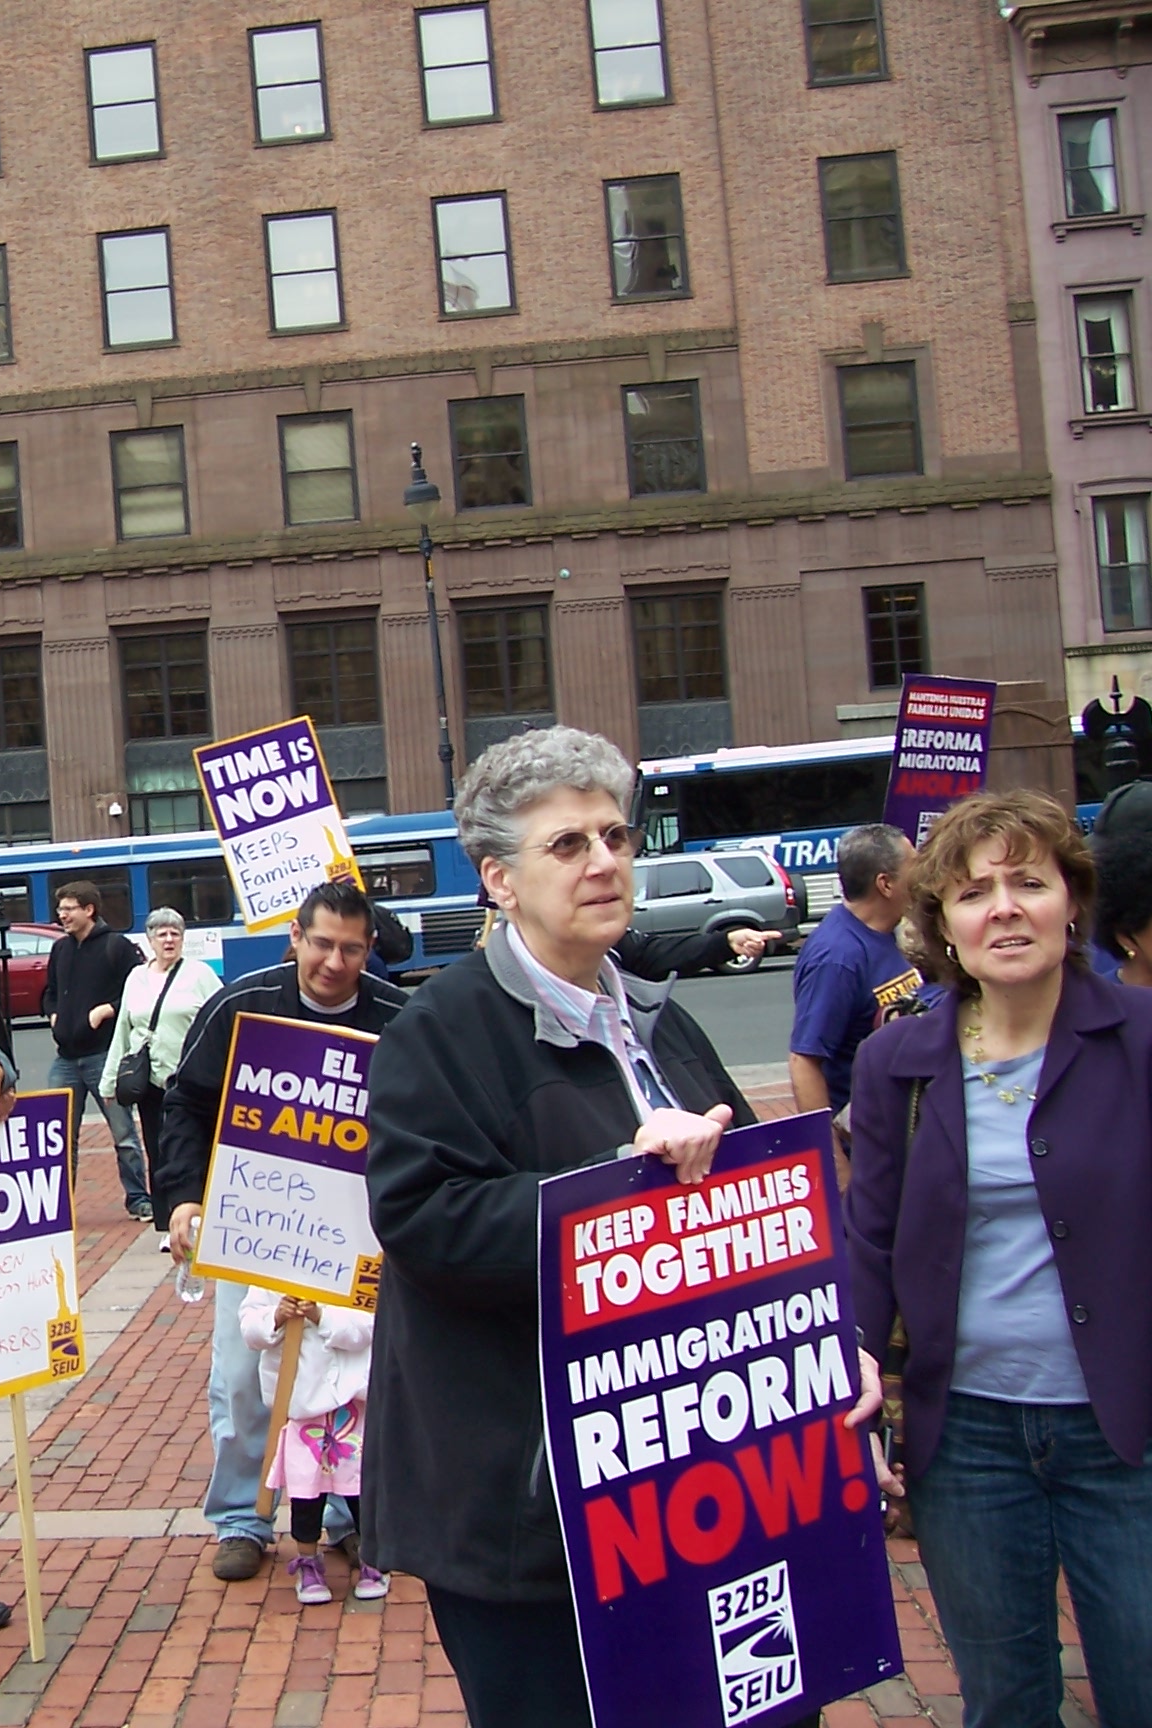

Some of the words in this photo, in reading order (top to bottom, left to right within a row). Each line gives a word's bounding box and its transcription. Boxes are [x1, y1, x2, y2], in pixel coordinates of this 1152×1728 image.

[202, 740, 286, 790] TIME
[287, 737, 315, 765] IS
[899, 753, 981, 772] MIGRATORIA
[216, 766, 319, 831] NOW
[231, 830, 298, 865] KEEPS
[322, 1048, 363, 1083] EL
[38, 1120, 64, 1157] IS
[230, 1105, 262, 1130] ES
[269, 1107, 369, 1152] AHO
[219, 1194, 347, 1245] Families
[573, 1203, 655, 1260] KEEP
[667, 1164, 811, 1236] FAMILIES
[576, 1206, 818, 1316] TOGETHER
[50, 1319, 78, 1338] 32BJ
[567, 1282, 841, 1404] IMMIGRATION
[52, 1358, 80, 1377] SEIU
[572, 1334, 853, 1490] REFORM
[584, 1414, 870, 1604] NOW!
[713, 1566, 786, 1627] 32BJ
[727, 1659, 799, 1720] SEIU
